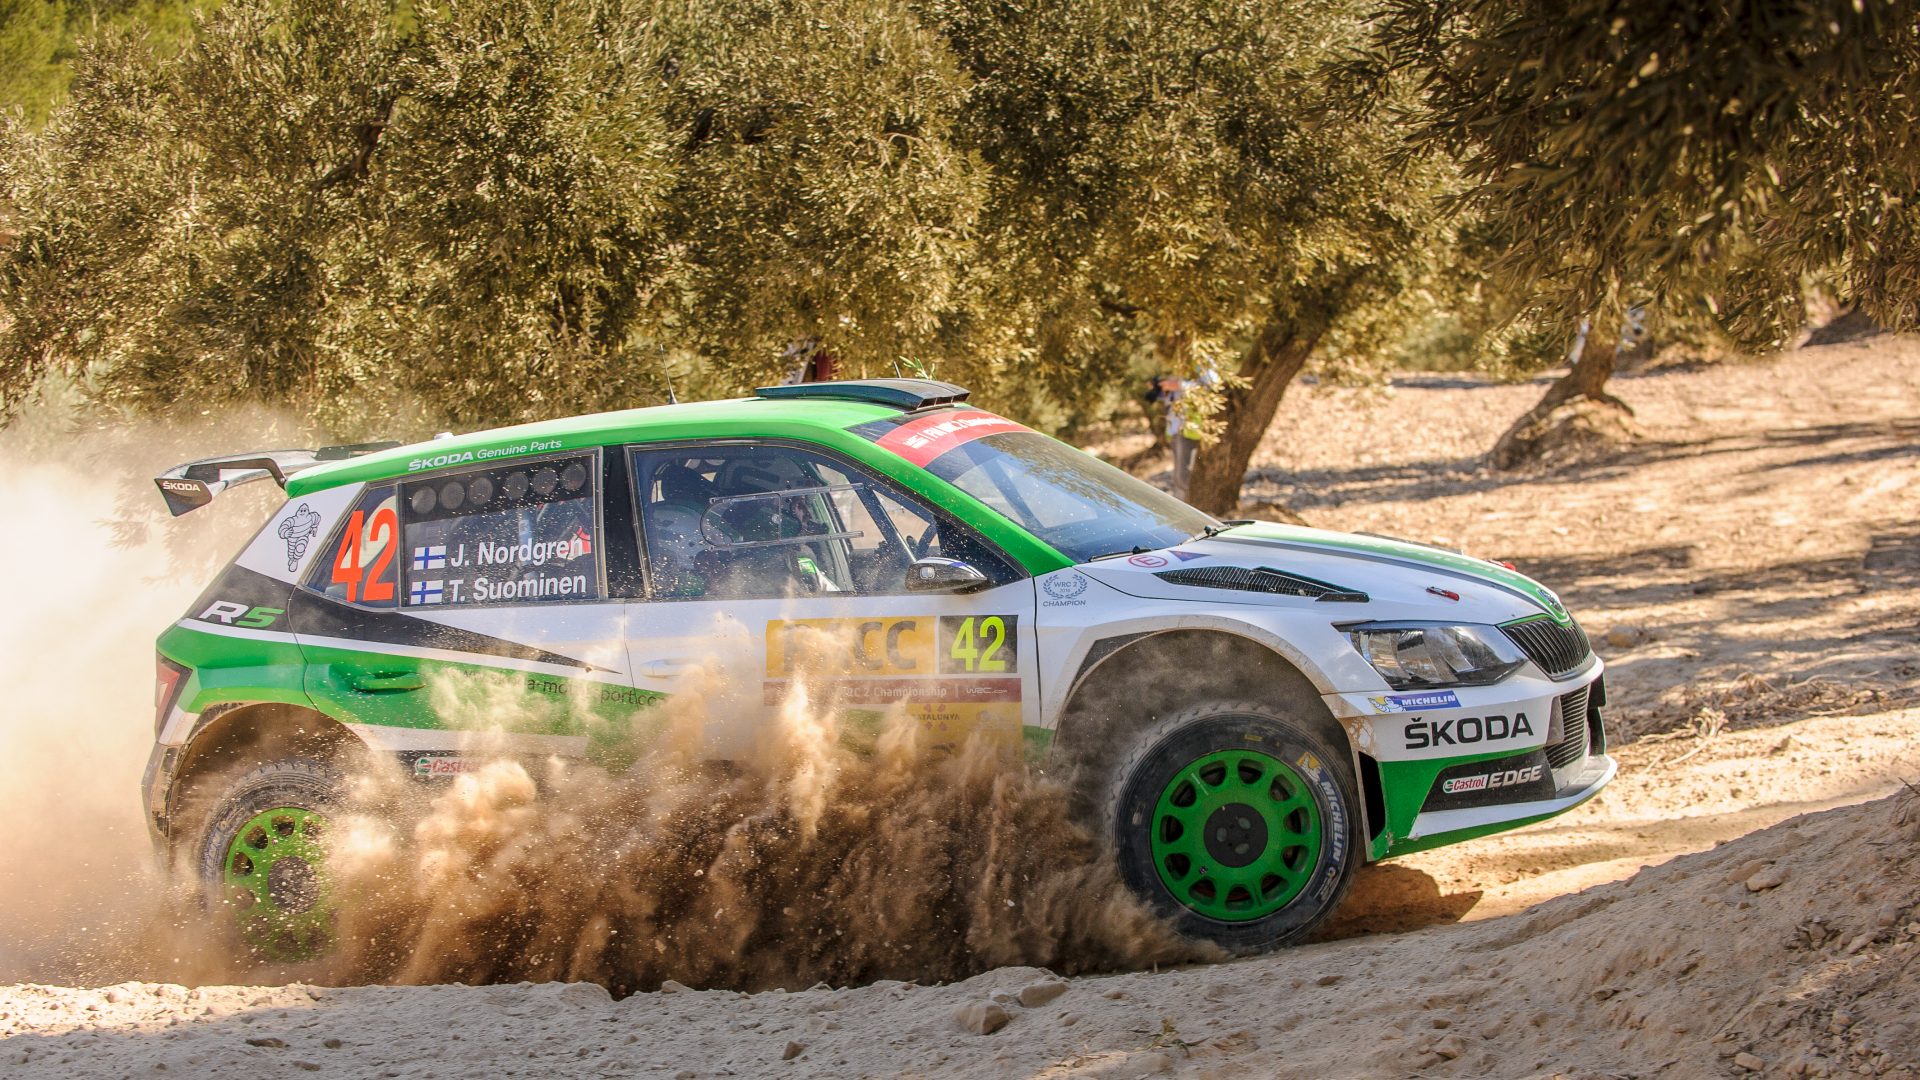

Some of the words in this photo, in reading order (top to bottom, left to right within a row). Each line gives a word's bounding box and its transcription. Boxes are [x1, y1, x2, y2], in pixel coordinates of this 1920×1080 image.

[408, 450, 474, 471] ŠKODA
[477, 445, 528, 460] Genuine
[531, 437, 563, 450] Parts
[162, 480, 201, 492] ŠKODA
[331, 508, 397, 602] 42
[451, 543, 470, 567] J.
[477, 537, 583, 567] Nordgren
[449, 579, 466, 602] T.
[473, 573, 587, 601] Suominen
[199, 601, 285, 628] R5
[951, 616, 1006, 672] 42
[873, 685, 947, 699] Championship
[1401, 694, 1457, 706] MICHELIN
[1404, 712, 1535, 750] ŠKODA
[1453, 776, 1486, 792] Castrol
[1486, 765, 1542, 789] EDGE
[1321, 780, 1345, 863] MICHELIN
